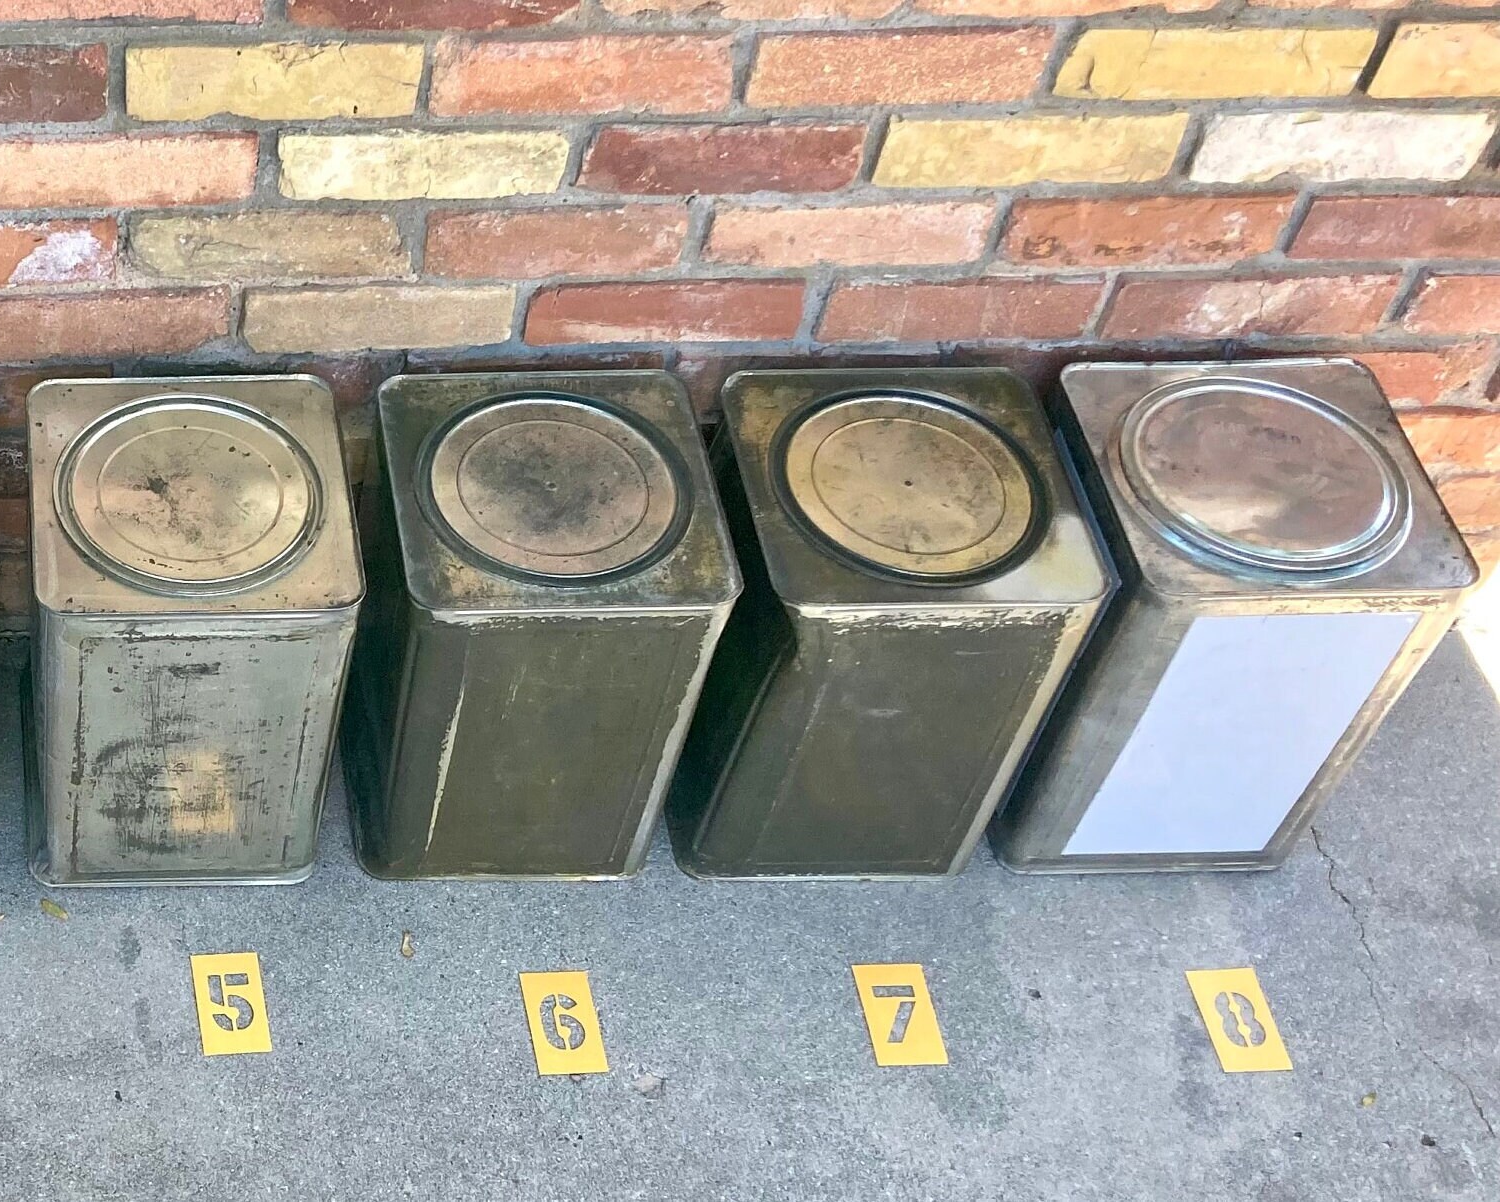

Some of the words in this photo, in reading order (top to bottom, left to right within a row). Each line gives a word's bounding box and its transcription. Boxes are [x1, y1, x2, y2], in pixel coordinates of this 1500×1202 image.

[207, 973, 253, 1031] 5
[539, 993, 586, 1050] 6
[872, 985, 916, 1043] 7
[1216, 992, 1267, 1047] 8
